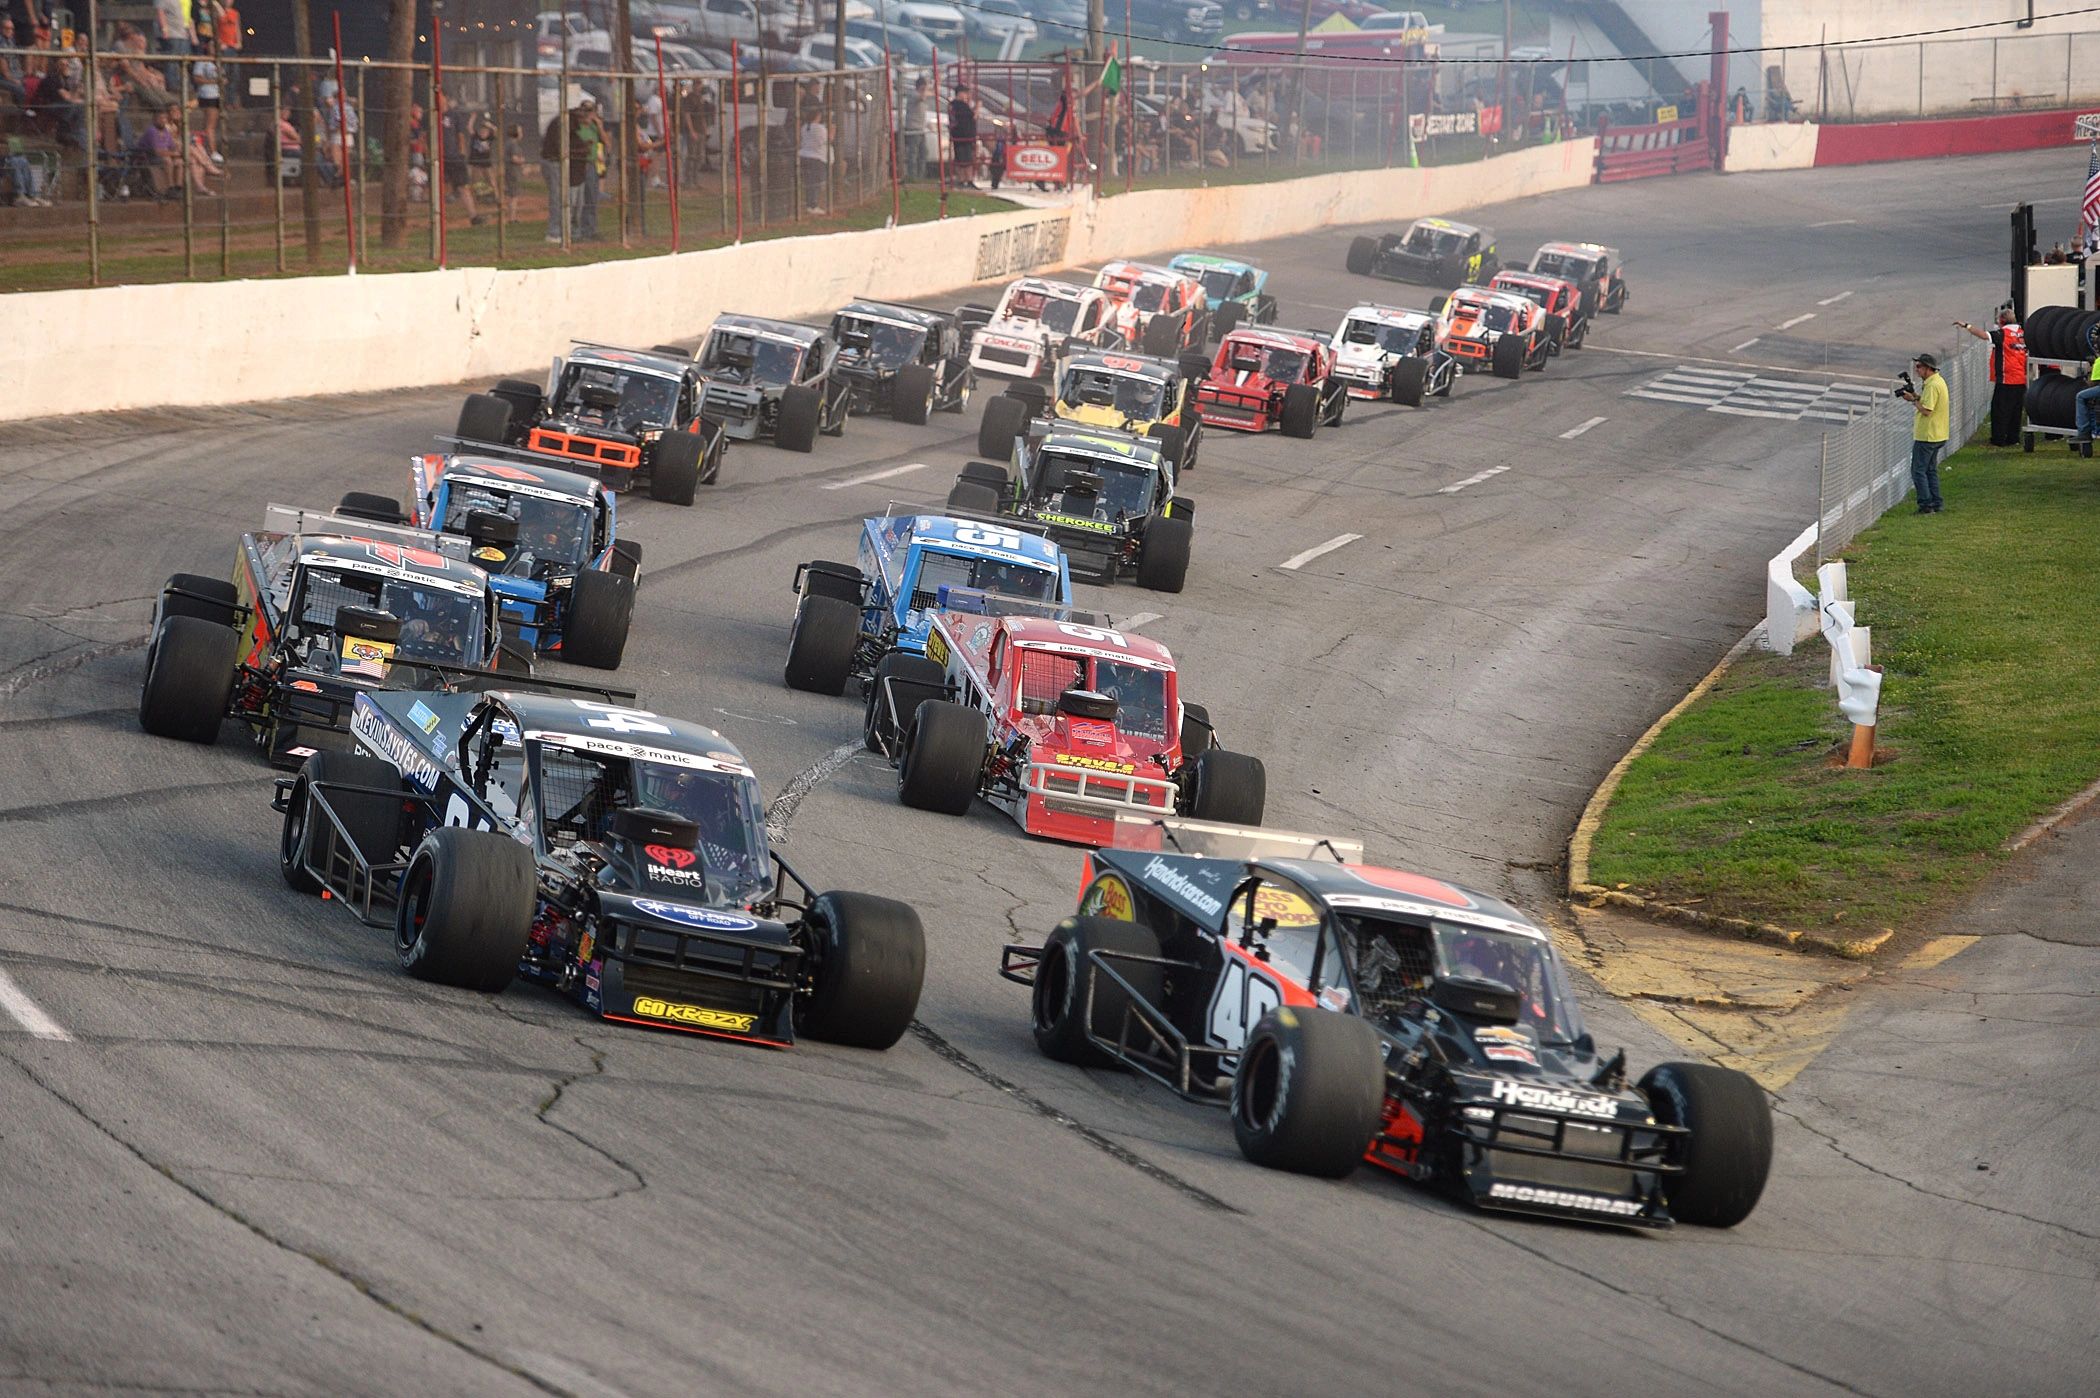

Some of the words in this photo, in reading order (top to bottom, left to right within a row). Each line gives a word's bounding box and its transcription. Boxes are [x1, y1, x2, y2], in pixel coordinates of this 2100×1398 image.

[1020, 153, 1051, 163] BELL
[984, 336, 1033, 350] CONCORD
[482, 480, 508, 489] pace
[524, 487, 552, 497] matic
[1036, 512, 1115, 532] CHEROKEE
[951, 543, 975, 551] pace
[991, 550, 1018, 560] matic
[352, 563, 382, 572] pace
[402, 572, 436, 584] matic
[1059, 645, 1087, 653] pace
[1105, 652, 1135, 662] matic
[586, 740, 624, 752] pace
[649, 750, 691, 764] matic
[1056, 754, 1136, 771] STEVE'S
[647, 864, 701, 881] iHeart
[650, 872, 702, 888] RADIO
[689, 914, 704, 922] OFF
[707, 915, 732, 926] ROAD
[1380, 901, 1418, 911] pace
[1449, 908, 1484, 922] matic
[1491, 1080, 1619, 1115] Hendrick
